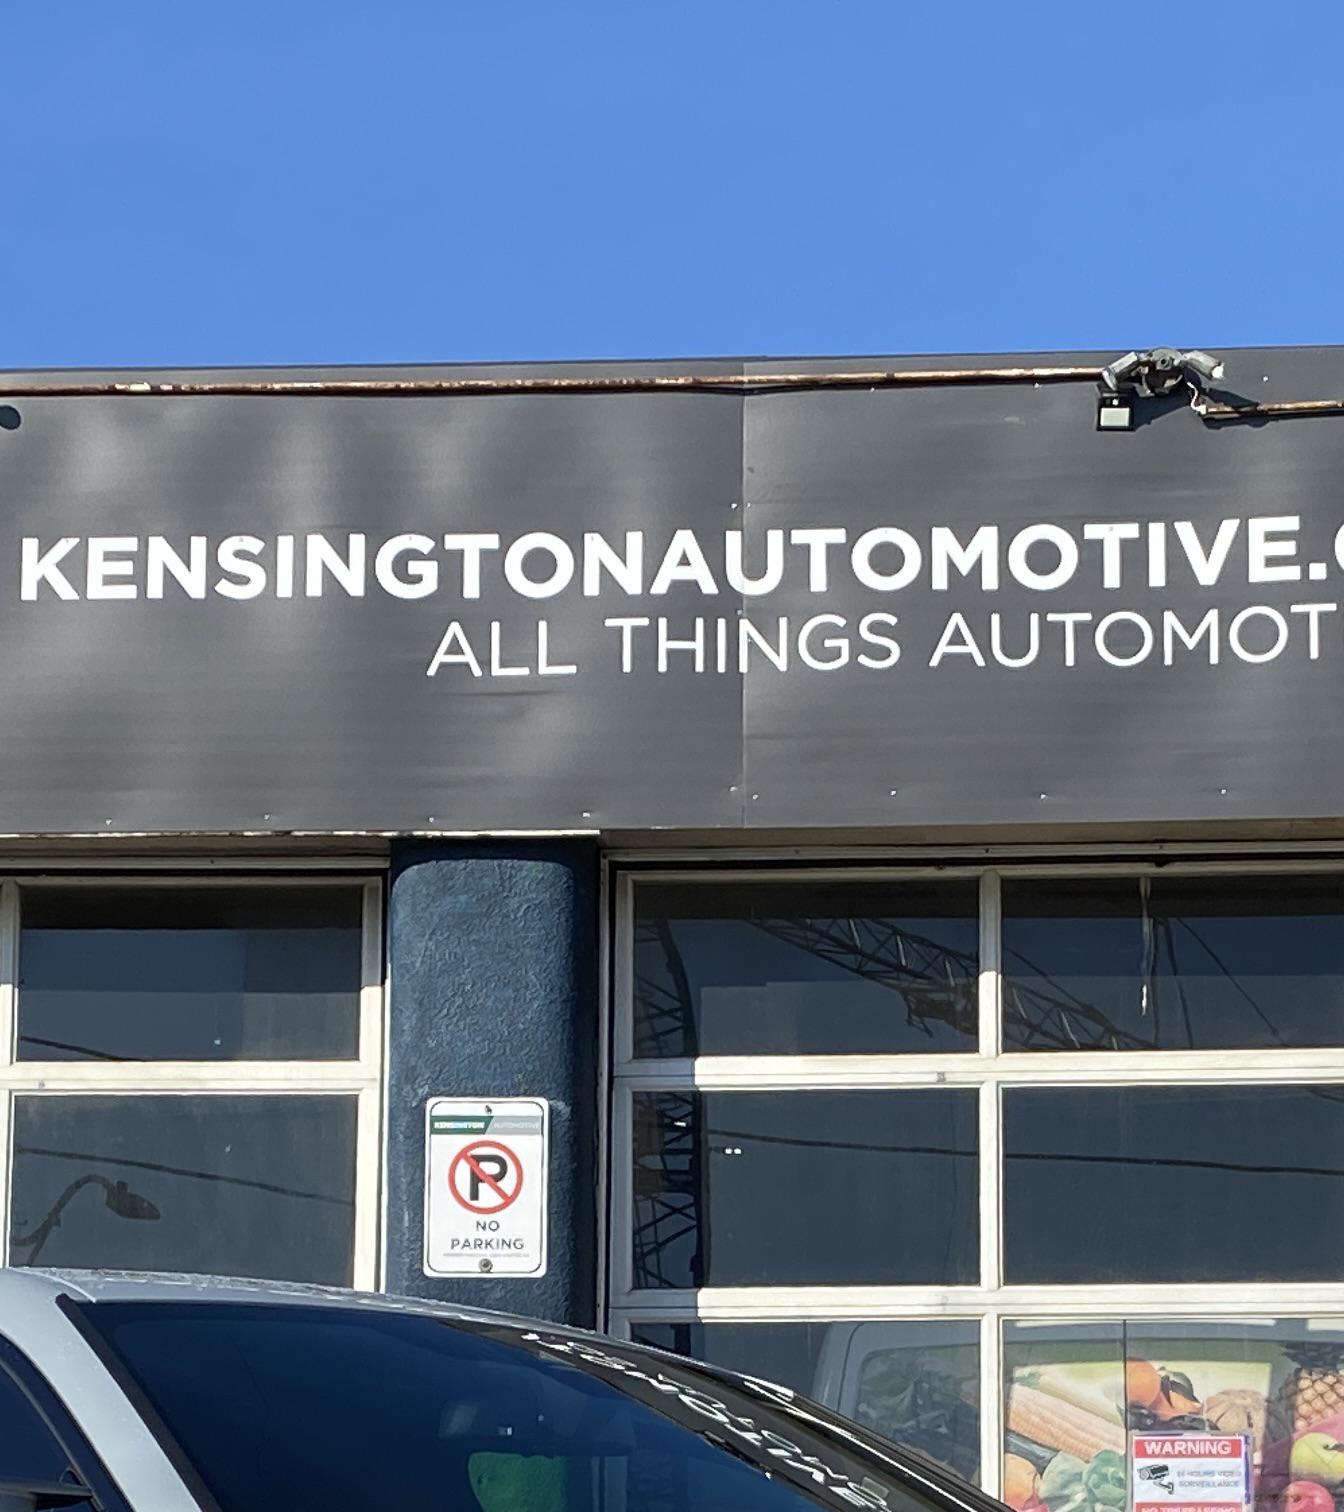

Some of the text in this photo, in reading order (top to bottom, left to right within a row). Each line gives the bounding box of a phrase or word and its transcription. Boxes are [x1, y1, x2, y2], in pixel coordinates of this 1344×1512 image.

[426, 620, 578, 677] ALL
[604, 612, 902, 674] THINGS
[476, 1220, 500, 1232] NO
[451, 1238, 524, 1250] PARKING
[1144, 1441, 1232, 1455] WARNING
